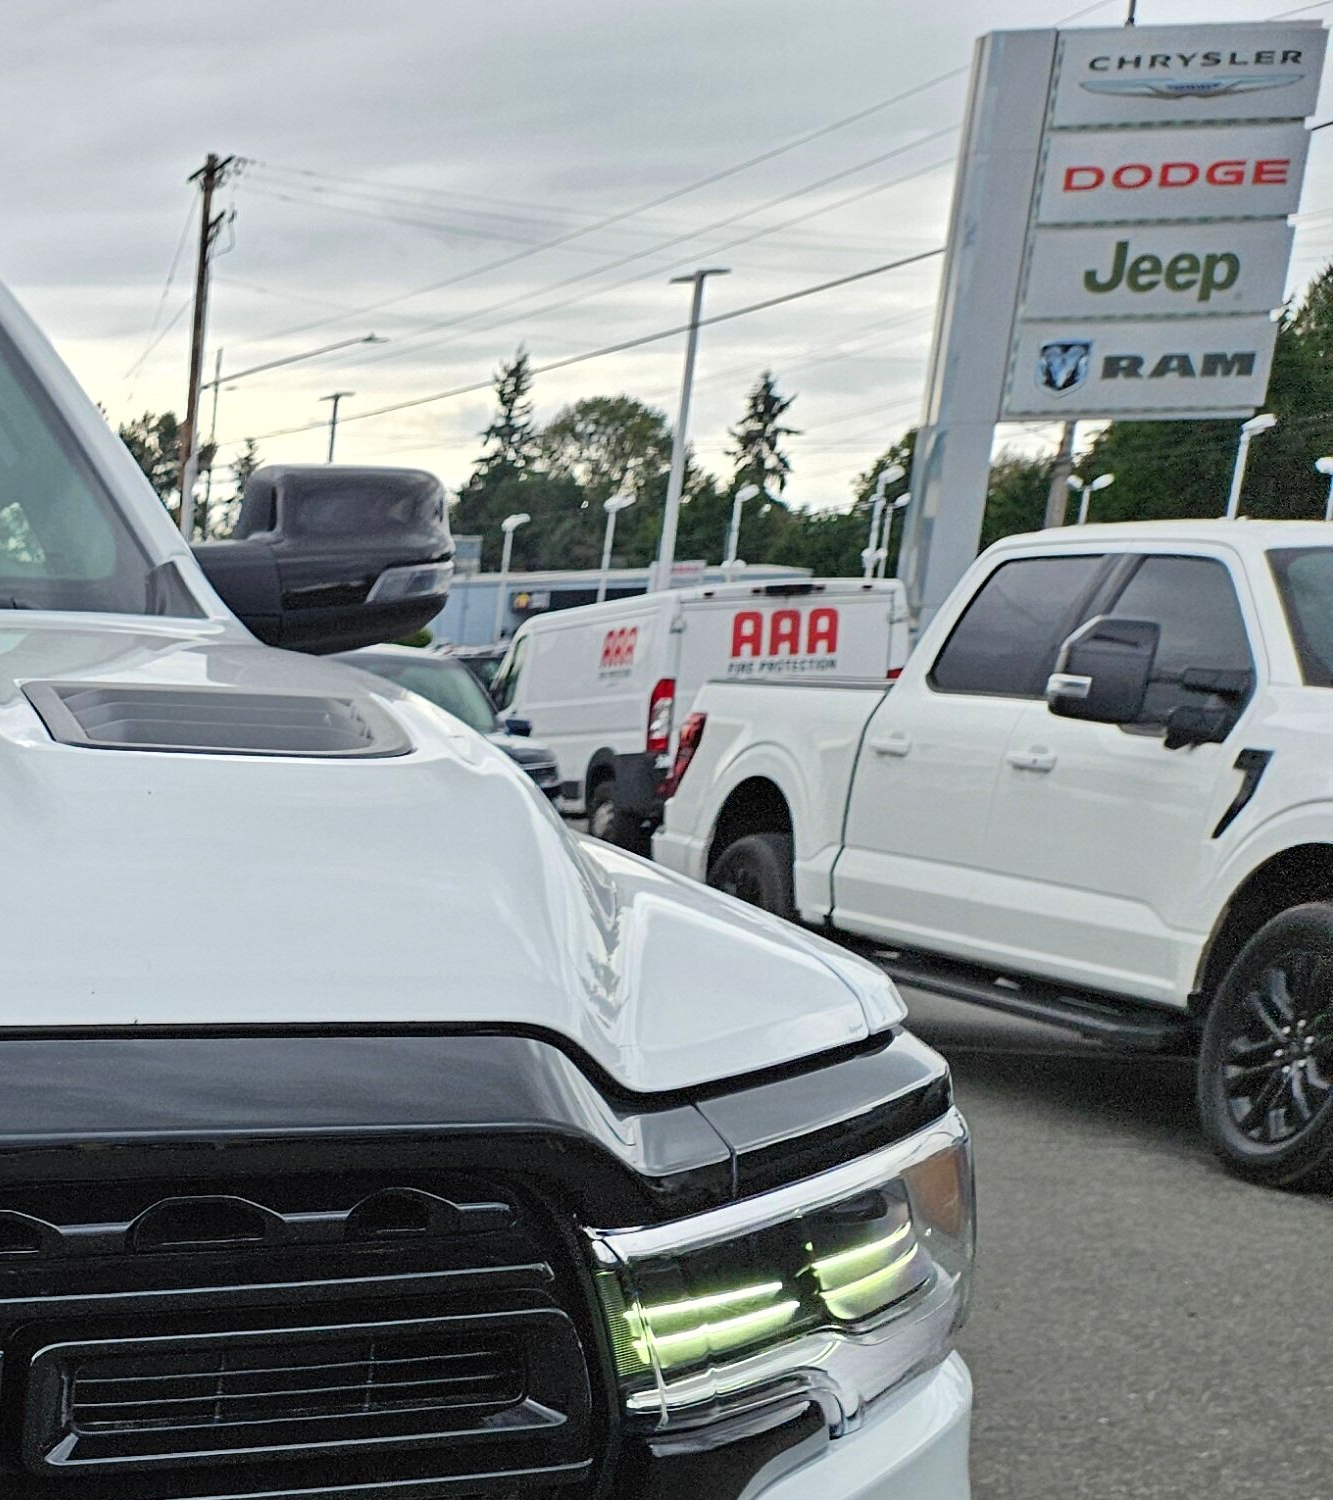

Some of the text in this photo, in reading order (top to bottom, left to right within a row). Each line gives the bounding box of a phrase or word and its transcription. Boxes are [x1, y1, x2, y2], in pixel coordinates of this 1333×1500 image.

[1088, 49, 1303, 72] CHRYSLER
[1062, 159, 1291, 193] DODGE
[1083, 240, 1241, 303] Jeep
[1099, 351, 1257, 381] RAM
[731, 607, 839, 657] AAA
